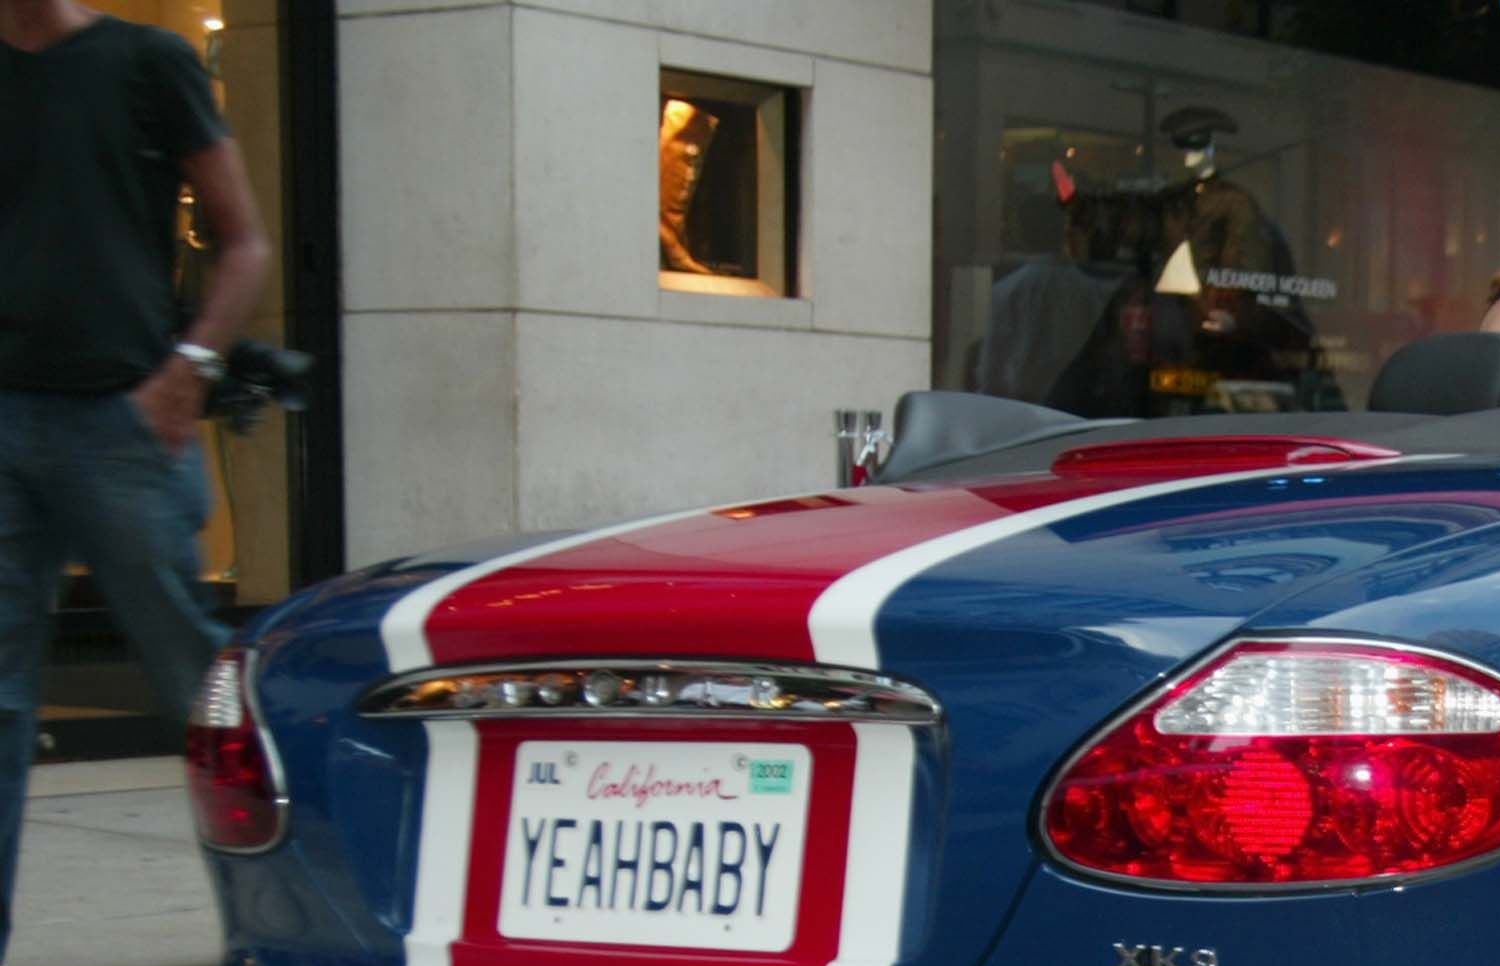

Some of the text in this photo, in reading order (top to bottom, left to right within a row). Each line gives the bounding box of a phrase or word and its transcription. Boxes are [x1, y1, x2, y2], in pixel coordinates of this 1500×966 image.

[1206, 268, 1277, 292] ALEXANDER
[526, 761, 561, 785] JUL
[756, 763, 788, 779] 2002
[586, 761, 739, 807] California
[520, 816, 780, 917] YEAHBABY
